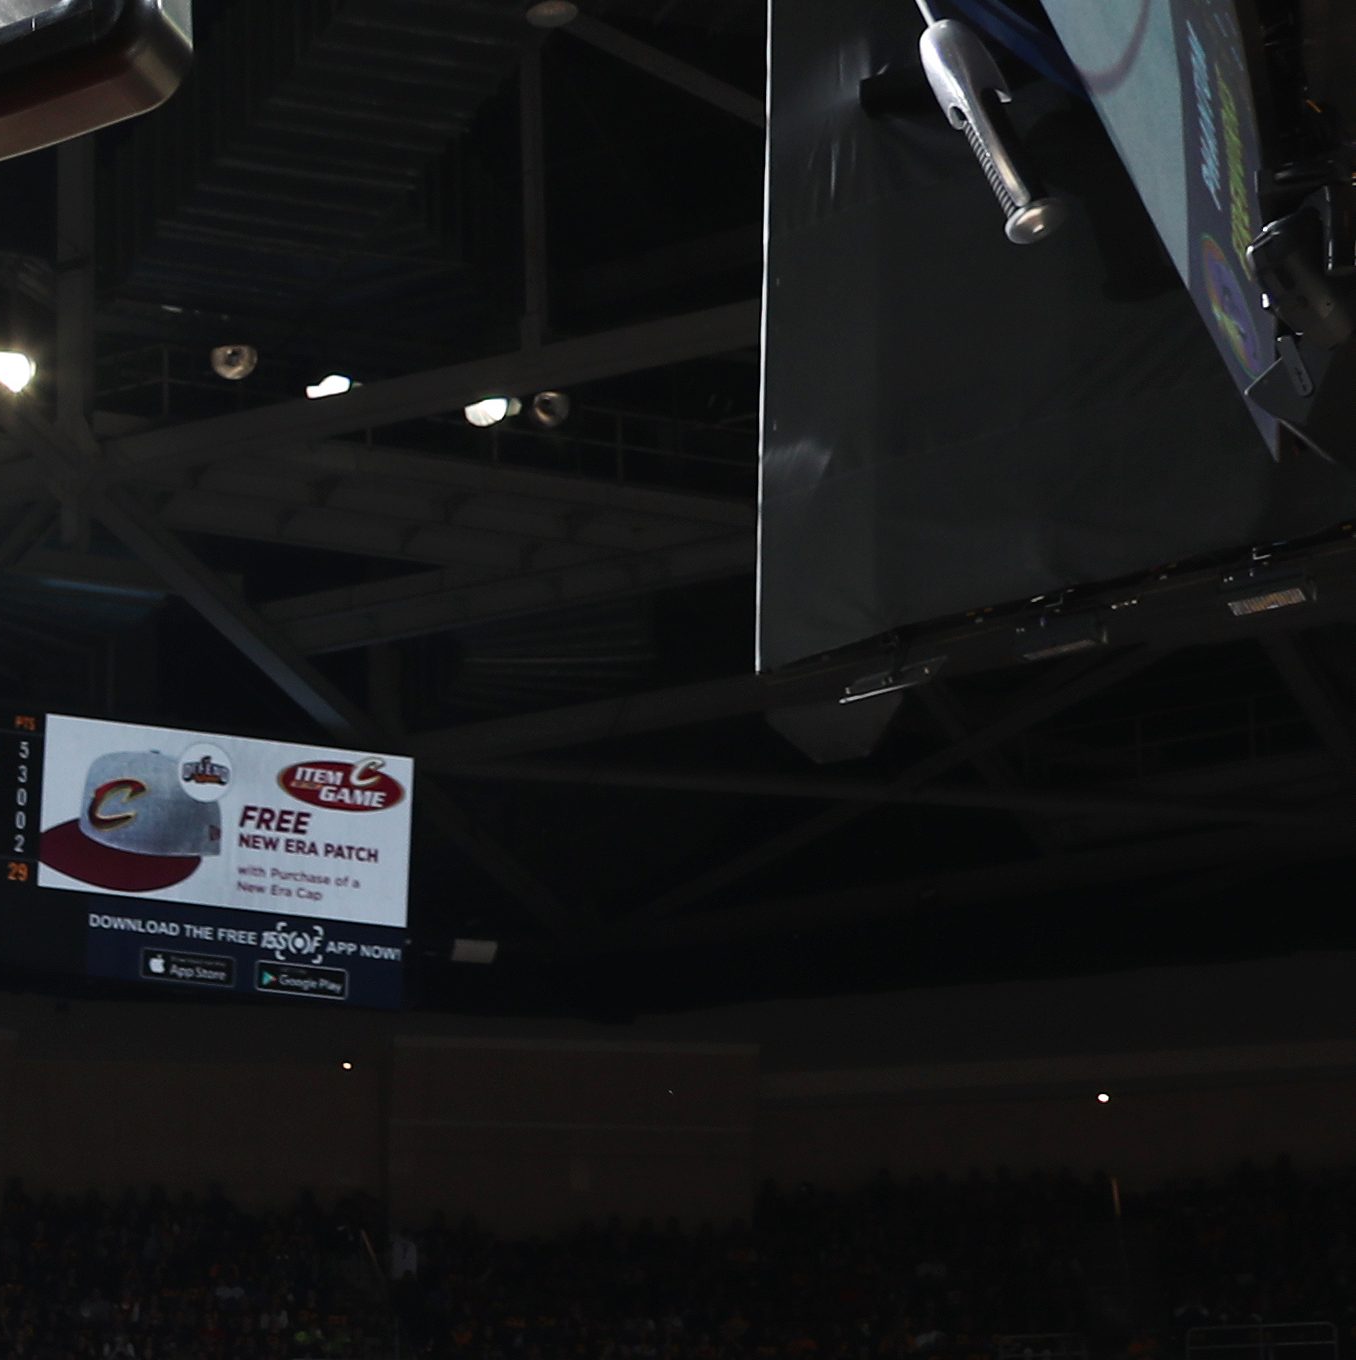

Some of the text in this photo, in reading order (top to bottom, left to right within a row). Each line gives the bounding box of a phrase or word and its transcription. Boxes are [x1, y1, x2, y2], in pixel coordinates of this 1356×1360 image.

[19, 740, 30, 759] 5
[17, 764, 29, 784] 3
[294, 767, 344, 785] ITEM
[16, 787, 28, 807] 0
[318, 785, 387, 808] GAME
[15, 810, 27, 830] 0
[239, 806, 311, 834] FREE
[13, 833, 25, 853] 2
[238, 834, 379, 862] NEW ERA PATCH
[7, 861, 30, 882] 29
[238, 865, 266, 877] with
[271, 868, 331, 885] Purchase
[335, 876, 349, 887] of
[237, 881, 323, 901] New Era Cap
[88, 913, 181, 937] DOWNLOAD
[183, 923, 214, 941] THE
[217, 927, 258, 946] FREE
[325, 942, 402, 961] APP NOW!
[279, 974, 344, 993] Google Play
